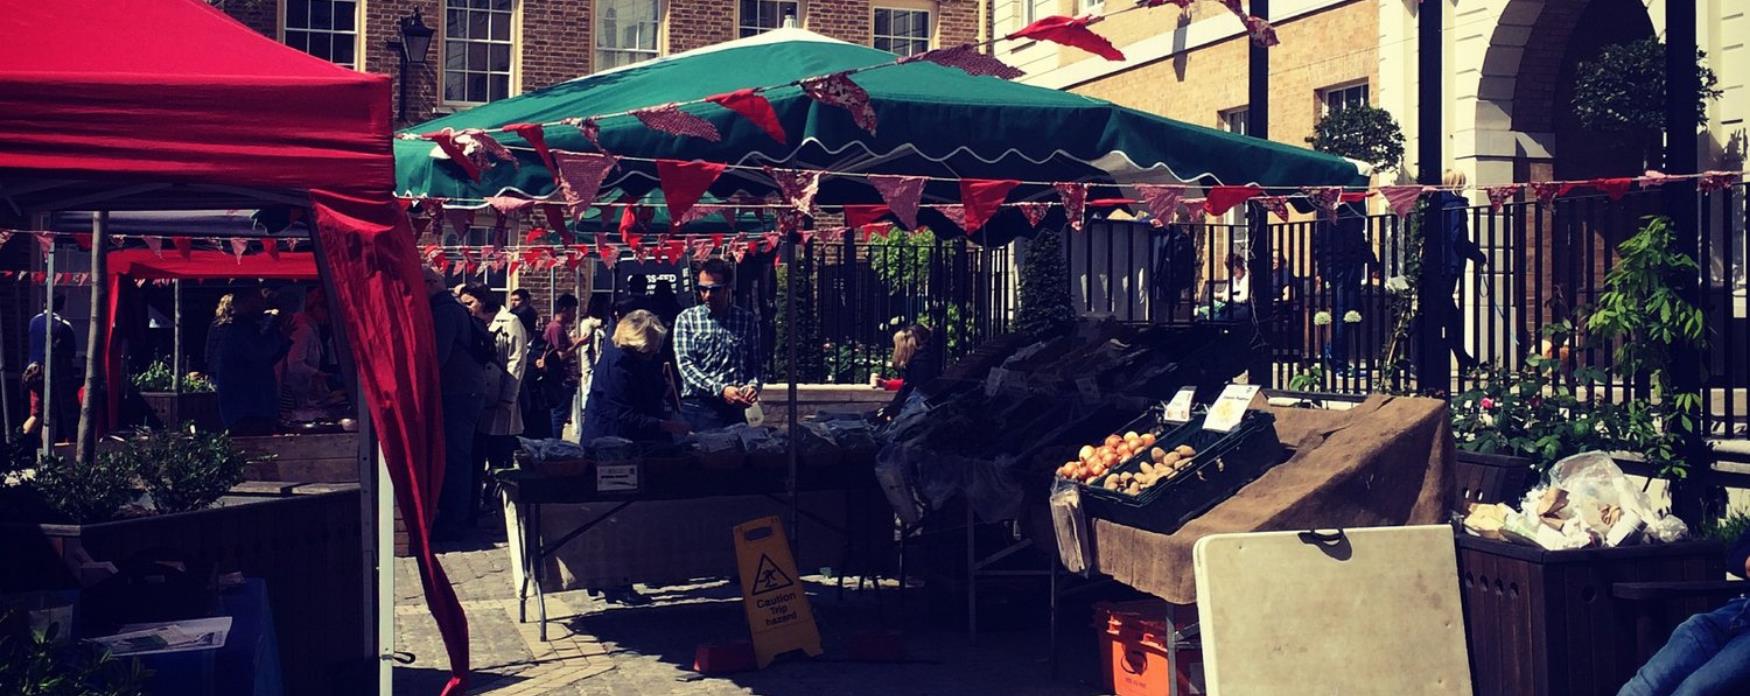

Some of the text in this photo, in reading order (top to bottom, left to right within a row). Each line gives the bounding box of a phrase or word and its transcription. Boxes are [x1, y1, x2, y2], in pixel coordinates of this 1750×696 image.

[756, 593, 797, 608] Caution
[770, 605, 788, 615] Trip
[766, 611, 797, 625] hazard
